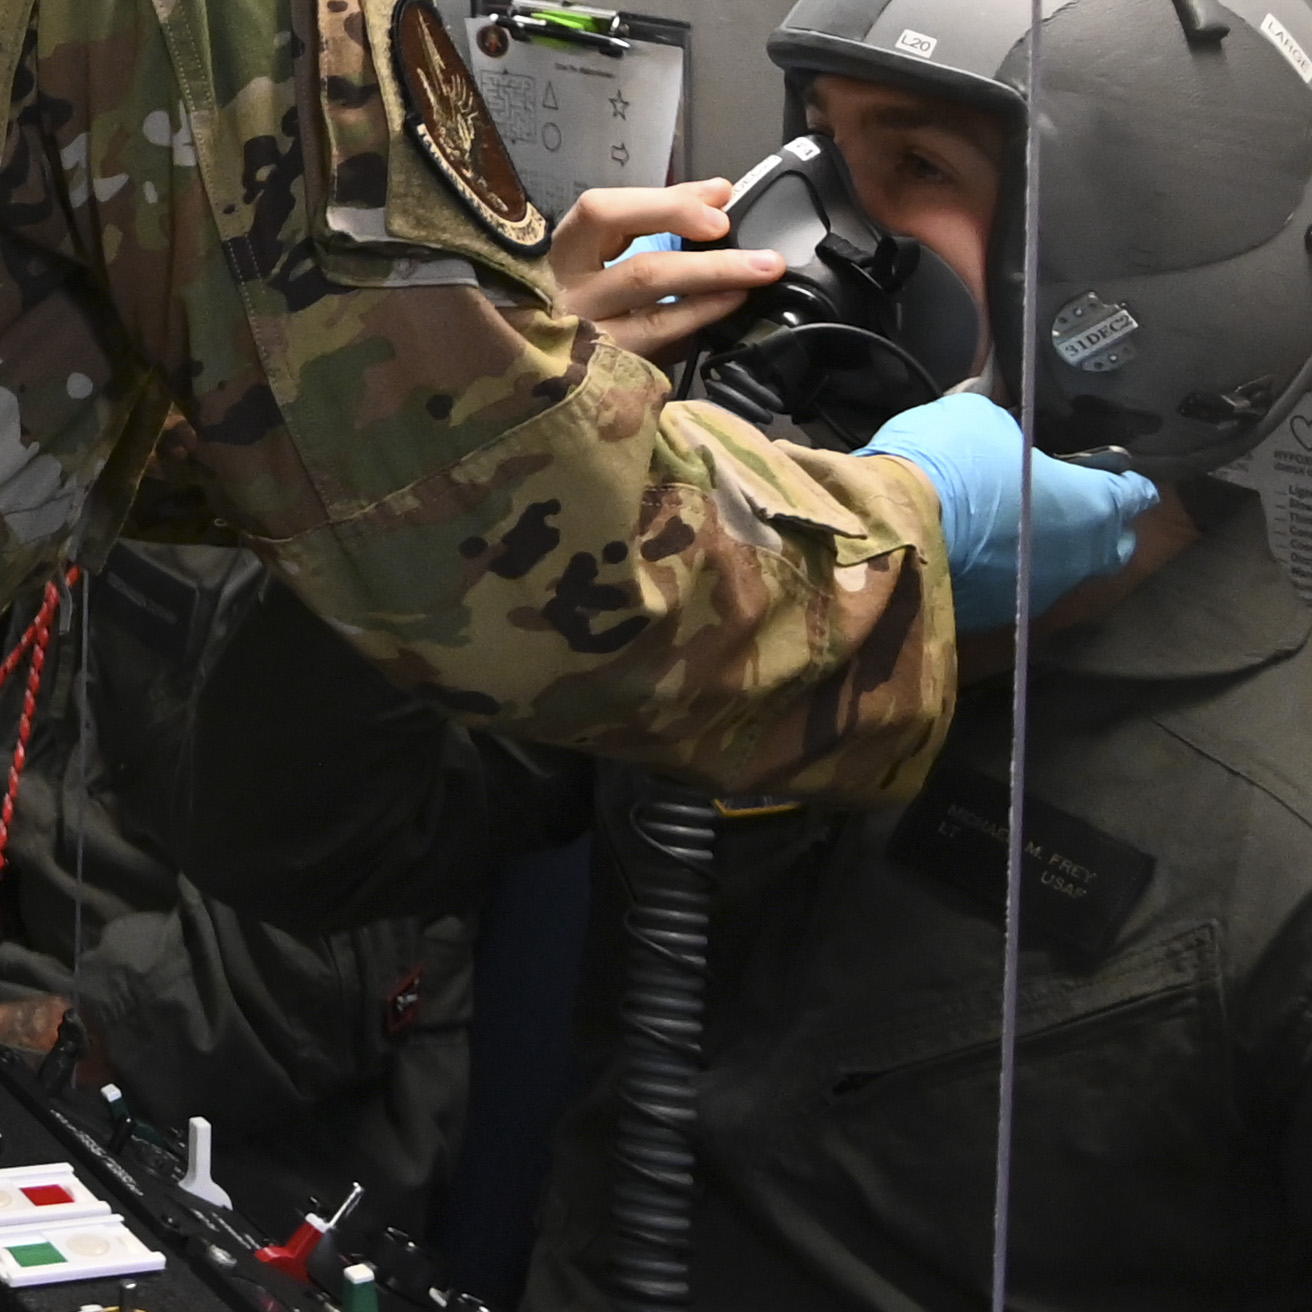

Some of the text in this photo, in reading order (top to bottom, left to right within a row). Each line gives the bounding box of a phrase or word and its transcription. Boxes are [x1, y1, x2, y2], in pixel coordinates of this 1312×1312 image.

[900, 33, 932, 53] L20
[1267, 20, 1311, 75] LARGE
[1048, 852, 1098, 884] FREY
[1040, 869, 1088, 899] USAF
